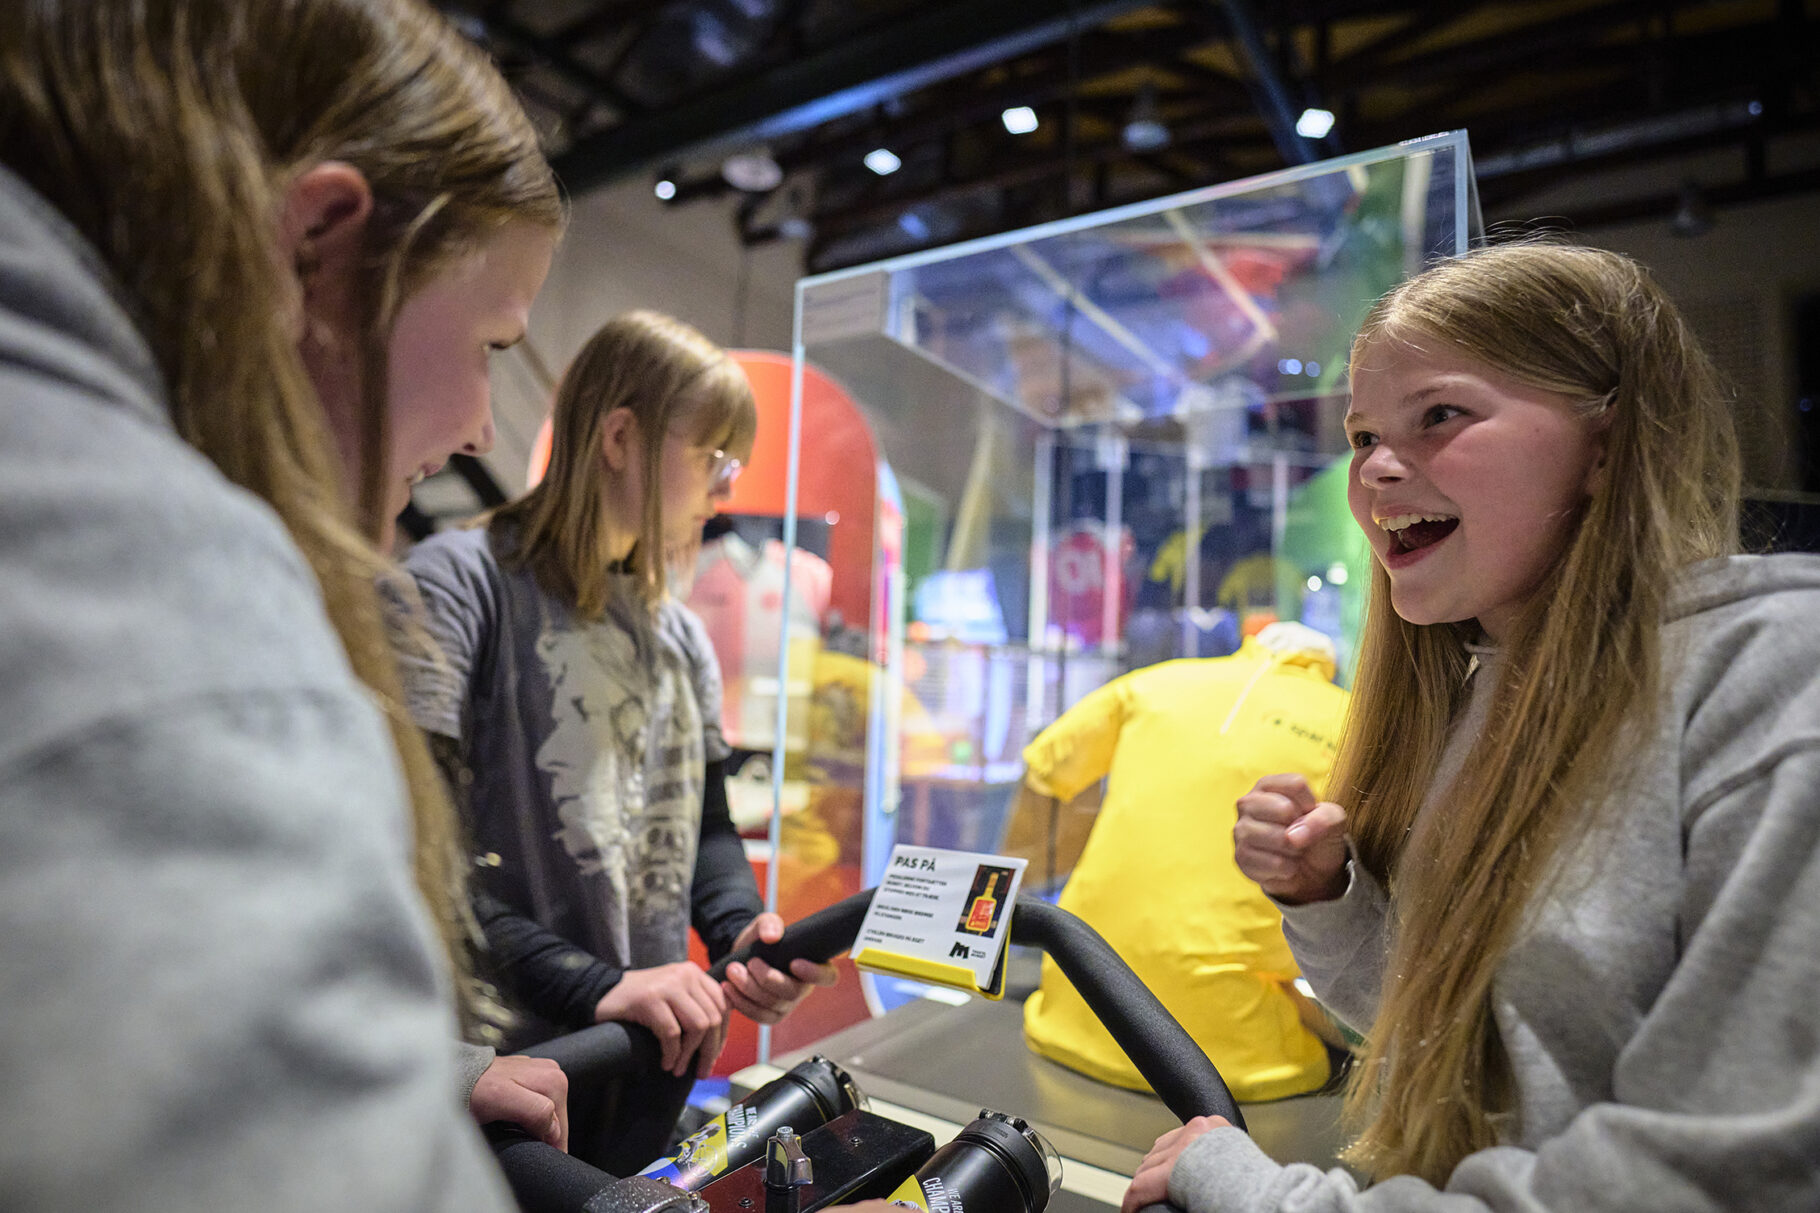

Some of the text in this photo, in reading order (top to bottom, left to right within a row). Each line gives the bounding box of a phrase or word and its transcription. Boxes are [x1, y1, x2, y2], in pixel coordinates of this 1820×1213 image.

[895, 856, 936, 872] PAS PÅ
[727, 1103, 747, 1149] AMPIONS
[947, 1187, 961, 1200] WE
